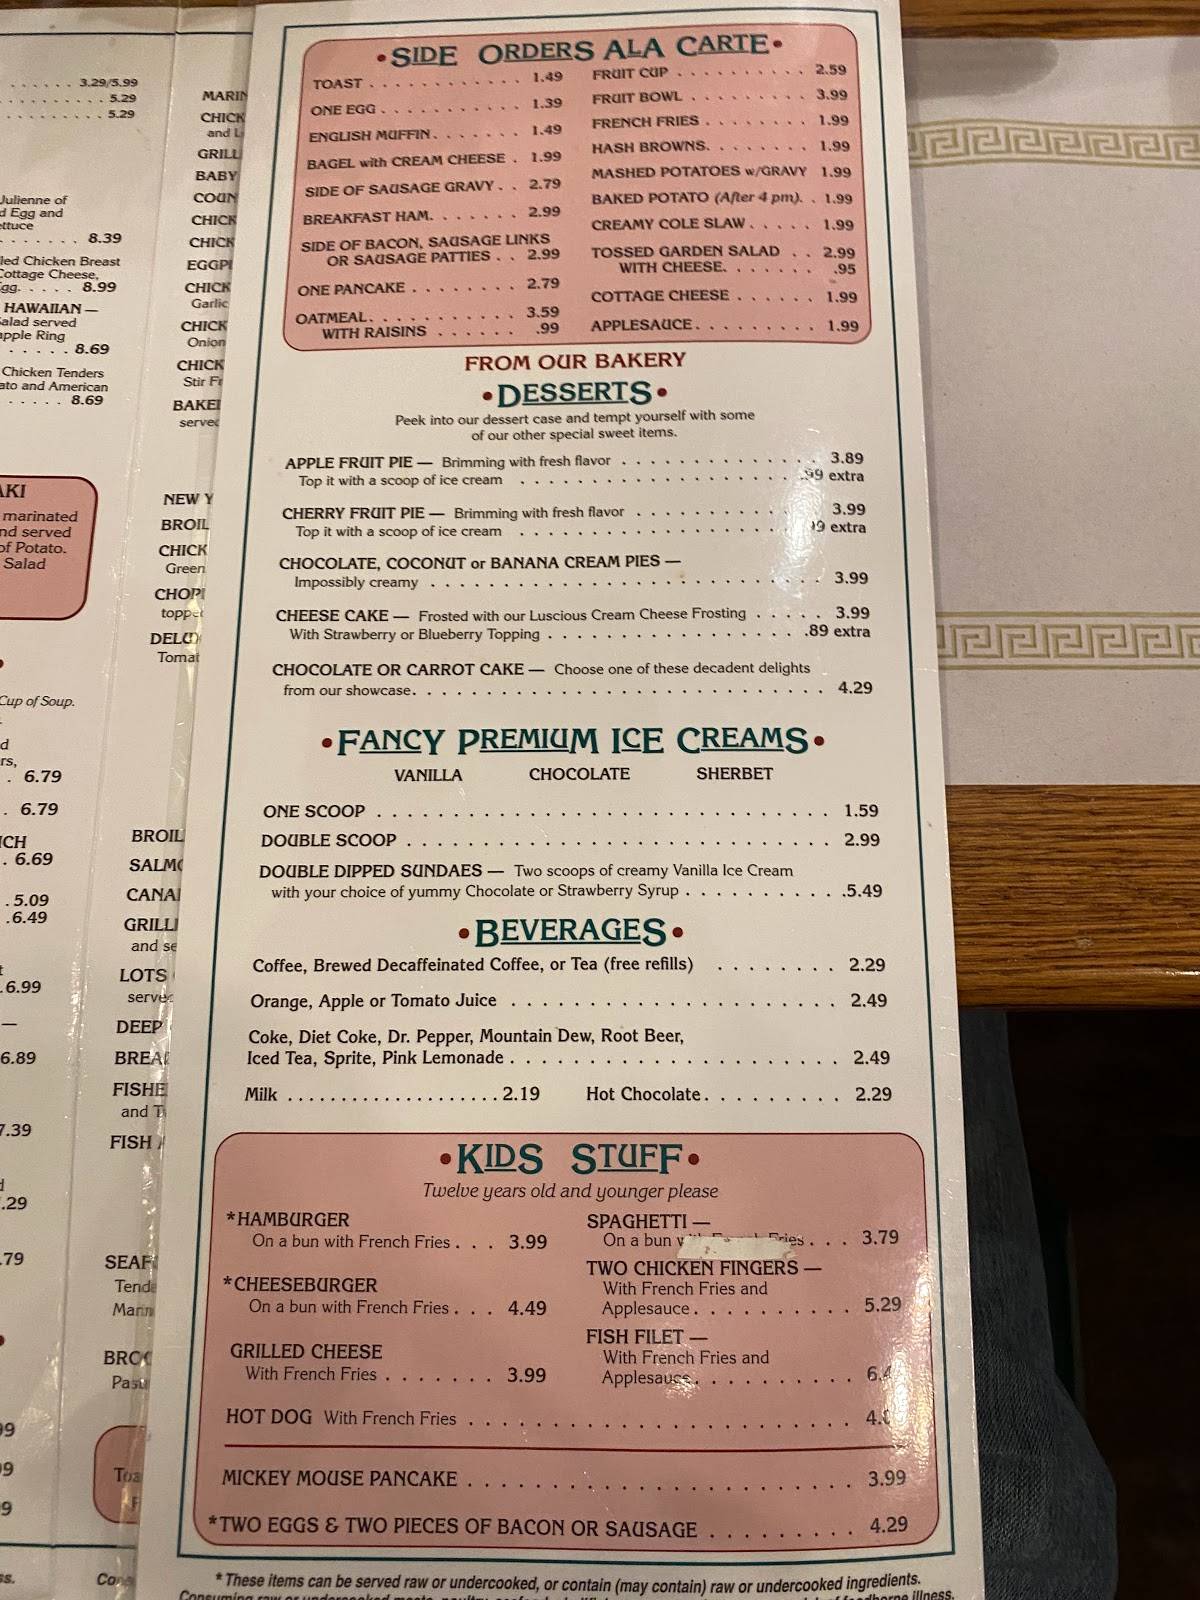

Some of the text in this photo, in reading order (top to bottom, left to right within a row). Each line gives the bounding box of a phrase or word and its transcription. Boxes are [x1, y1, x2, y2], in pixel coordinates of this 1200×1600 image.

[391, 34, 769, 67] SIDE ORDERS ALA CARTE
[593, 64, 846, 80] FRUIT CUP 2.59
[80, 79, 138, 88] 3.29/5.99
[313, 71, 563, 89] TOAST 1.49
[110, 94, 136, 103] 5.29
[593, 89, 847, 104] FRUIT BOWL 3.99
[310, 98, 562, 116] ONE EGG 1.39
[207, 128, 230, 137] and
[307, 151, 561, 170] BAGEL with CREAM CHEESE 1.99
[196, 171, 237, 182] BABY
[592, 166, 851, 179] MASHED POTATOES w/GRAVY 1.99
[13, 208, 63, 220] Egg and
[88, 233, 121, 243] 8.39
[23, 256, 120, 266] Chicken Breast
[48, 269, 98, 280] Cheese,
[83, 282, 116, 292] 8.99
[298, 278, 559, 296] ONE PANCAKE 2.79
[4, 303, 81, 314] HAWAIIAN
[36, 330, 65, 343] Ring
[323, 328, 360, 339] WITH
[365, 326, 426, 338] RAISINS
[75, 344, 109, 354] 8.69
[466, 352, 686, 371] FROM OUR BAKERY
[2, 366, 104, 378] Chicken Tenders
[22, 381, 108, 392] and American
[71, 395, 103, 405] 8.69
[498, 381, 652, 407] DESSERTS
[472, 430, 485, 440] of
[513, 430, 546, 440] other
[550, 428, 594, 442] special
[599, 428, 634, 438] sweet
[639, 427, 677, 437] items.
[285, 452, 863, 470] APPLE FRUIT PIE Brimming with fresh flavor 3.89
[3, 511, 77, 522] marinated
[22, 527, 71, 537] served
[15, 542, 66, 553] Potato.
[3, 557, 46, 569] Salad
[295, 572, 868, 590] Impossibly creamy 3.99
[276, 607, 870, 622] CHEESE CAKE Frosted with our Luscious Cream Cheese Frosting 3.99
[26, 696, 74, 709] of Soup.
[337, 727, 808, 756] FANCY PREMIUM ICE CREAMS
[25, 770, 61, 783] 6.79
[395, 767, 773, 781] VANILLA CHOCOLATE SHERBET
[21, 803, 58, 815] 6.79
[264, 804, 878, 818] ONE SCOOP 1.59
[262, 833, 880, 847] DOUBLE SCOOP 2.99
[15, 852, 53, 865] 6.69
[475, 918, 666, 947] BEVERAGES
[120, 969, 167, 982] LOTS
[251, 993, 887, 1011] Orange, Apple or Tomato Juice 2.49
[249, 1028, 683, 1047] Coke, Diet Coke, Dr. Pepper, Mountain Dew, Root Beer,
[245, 1086, 539, 1101] Milk 2.19
[856, 1087, 892, 1101] 2.29
[110, 1135, 152, 1149] FISH
[457, 1144, 682, 1174] KIDS STUFF
[424, 1183, 718, 1202] Twelve years old and younger please
[587, 1260, 798, 1275] TWO CHICKEN FINGERS
[865, 1297, 901, 1312] 5.29
[231, 1343, 382, 1359] GRILLED CHEESE
[246, 1366, 546, 1382] With French Fries 3.99
[223, 1470, 906, 1487] MICKEY MOUSE PANCAKE 3.99
